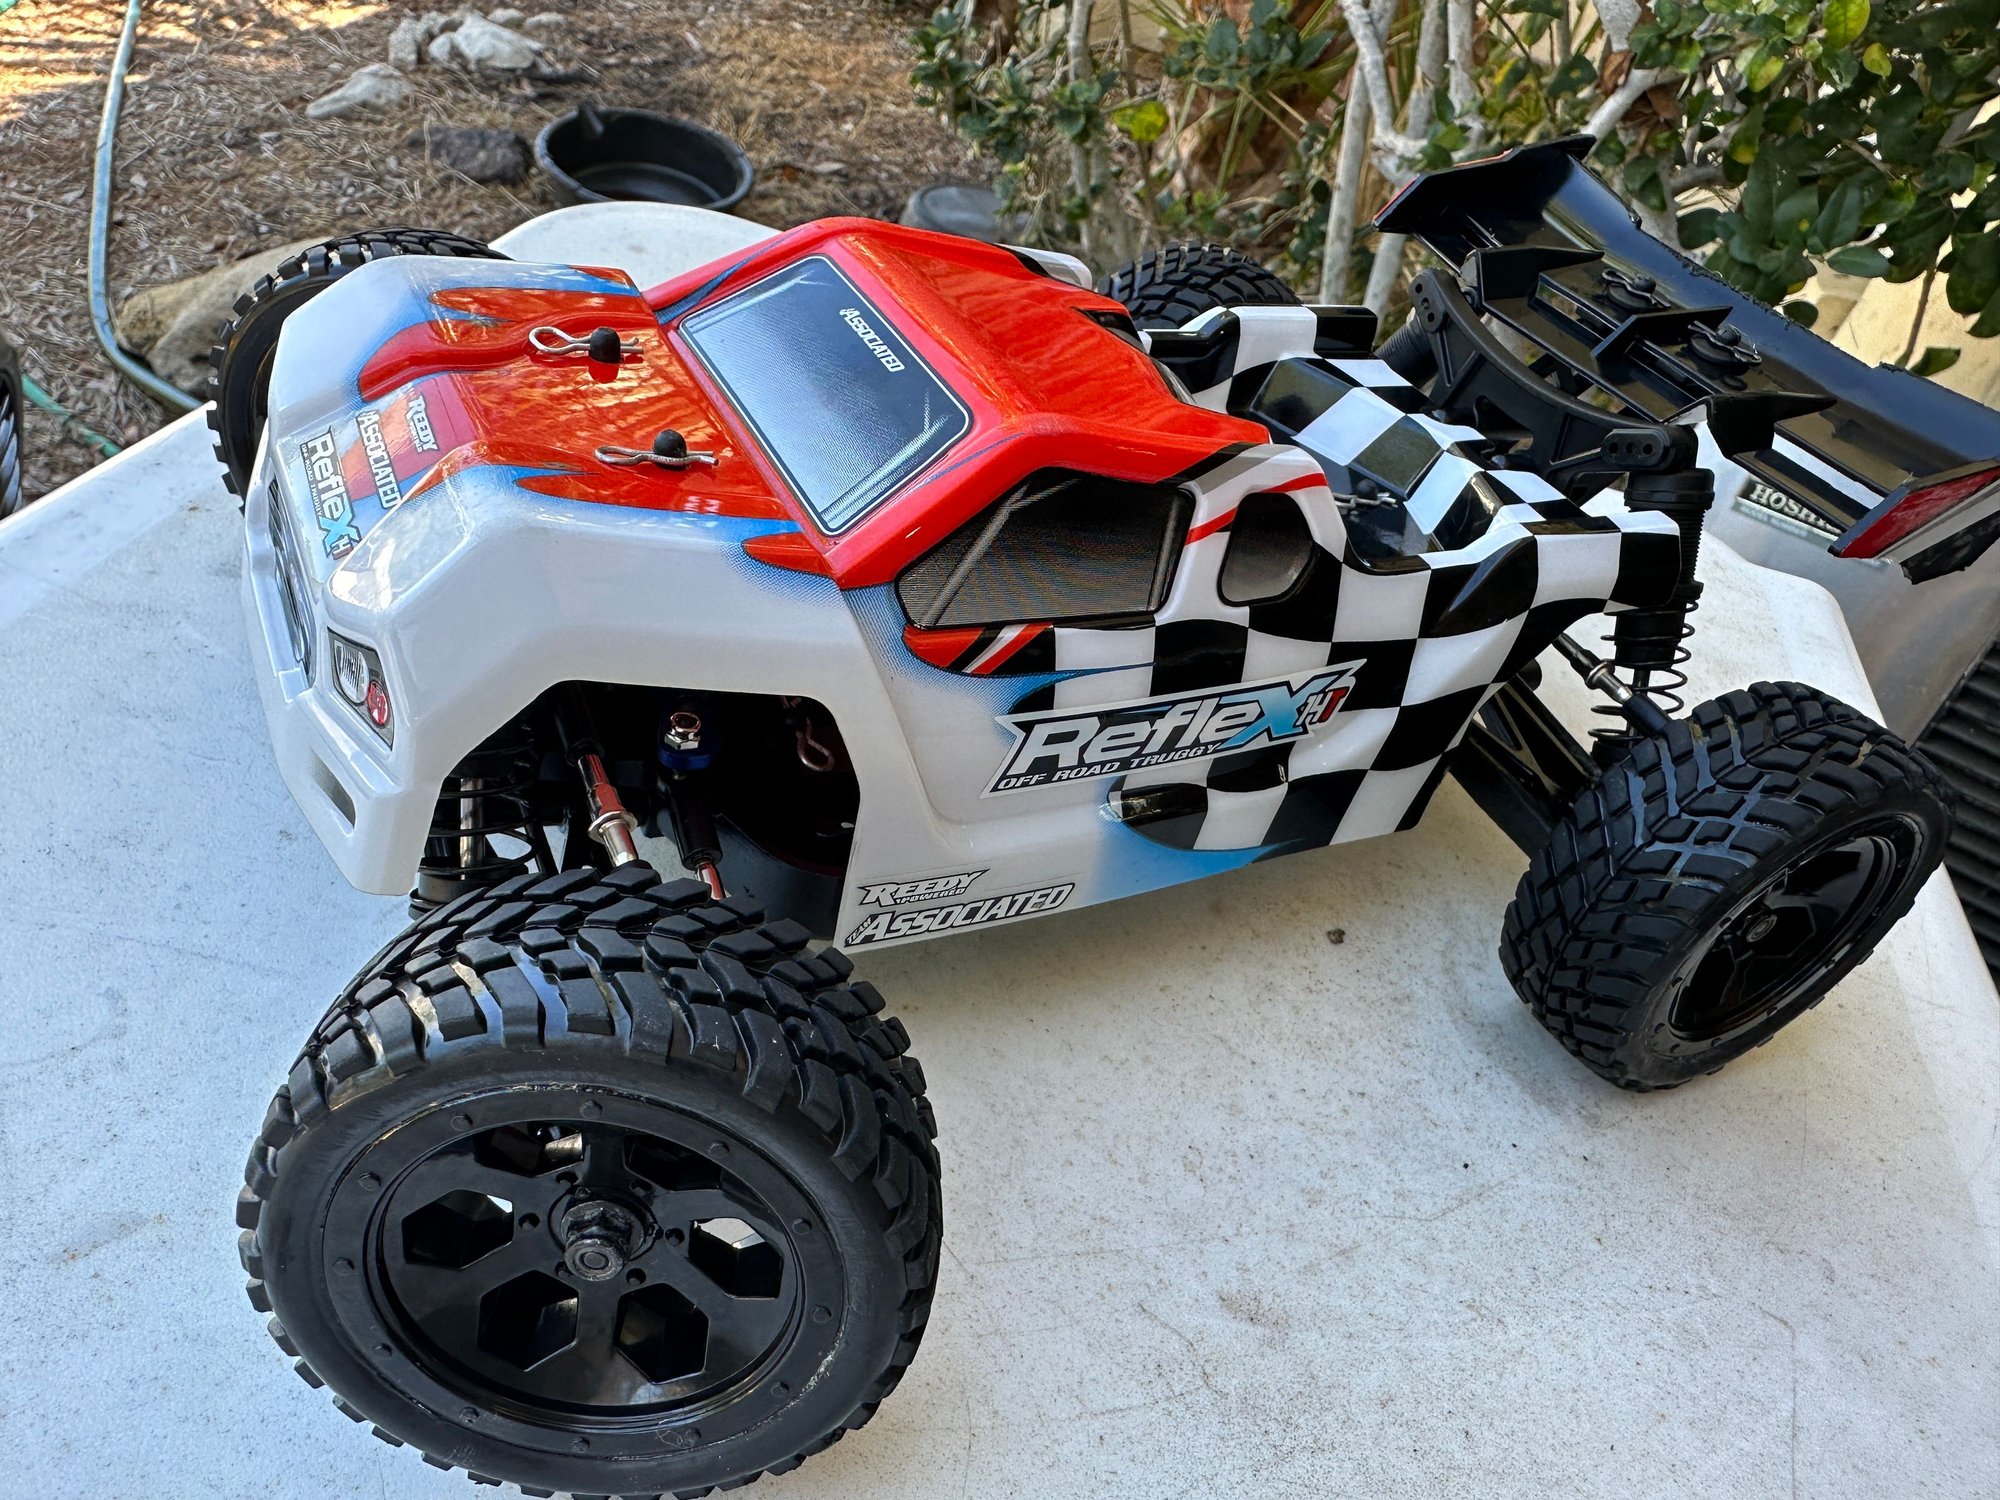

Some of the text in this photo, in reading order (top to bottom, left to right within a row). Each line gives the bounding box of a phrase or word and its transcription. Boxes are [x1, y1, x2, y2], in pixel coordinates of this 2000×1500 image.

[842, 307, 905, 372] ASSOCIATED
[405, 395, 438, 450] REEDY
[358, 412, 402, 509] ASSOCIATED
[998, 743, 1220, 791] OFF ROAD TRUGGY
[850, 884, 1074, 944] ASSOCIATED
[860, 871, 987, 907] REEDY
